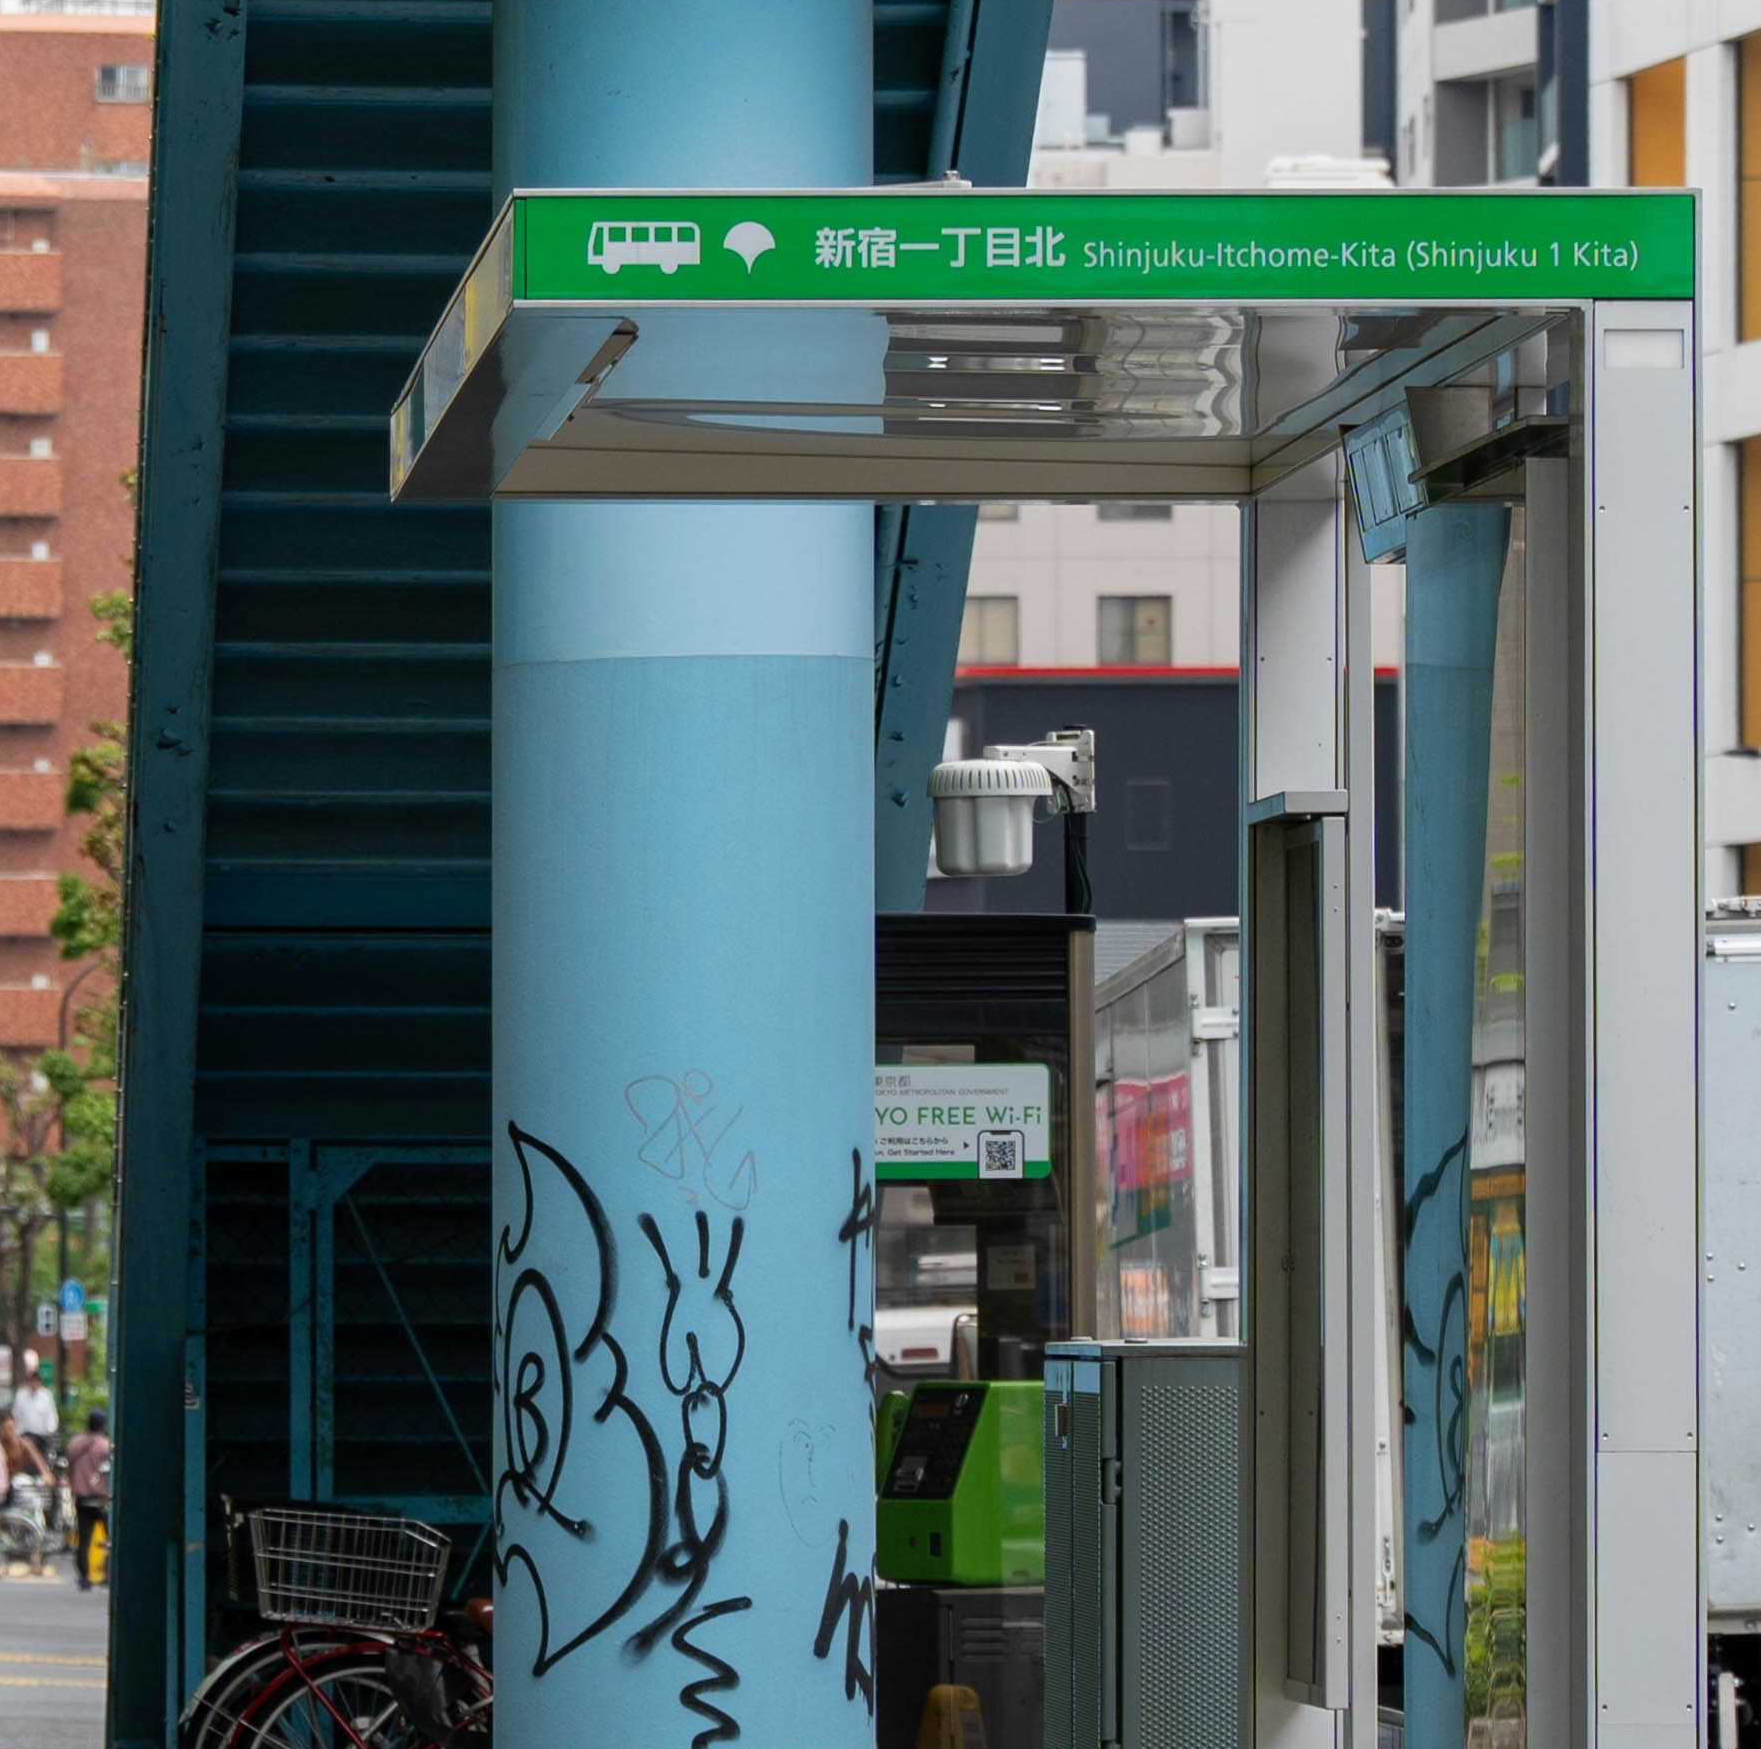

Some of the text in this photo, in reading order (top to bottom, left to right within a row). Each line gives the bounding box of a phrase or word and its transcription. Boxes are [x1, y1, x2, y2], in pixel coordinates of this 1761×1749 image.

[814, 225, 1067, 268] 新宿一丁目北
[1083, 240, 1640, 276] Shinjuku-Itchome-Kita (Shinjuku 1 Kita)
[917, 1106, 976, 1125] FREE
[985, 1106, 1042, 1125] Wi-Fi
[904, 1148, 934, 1156] Started
